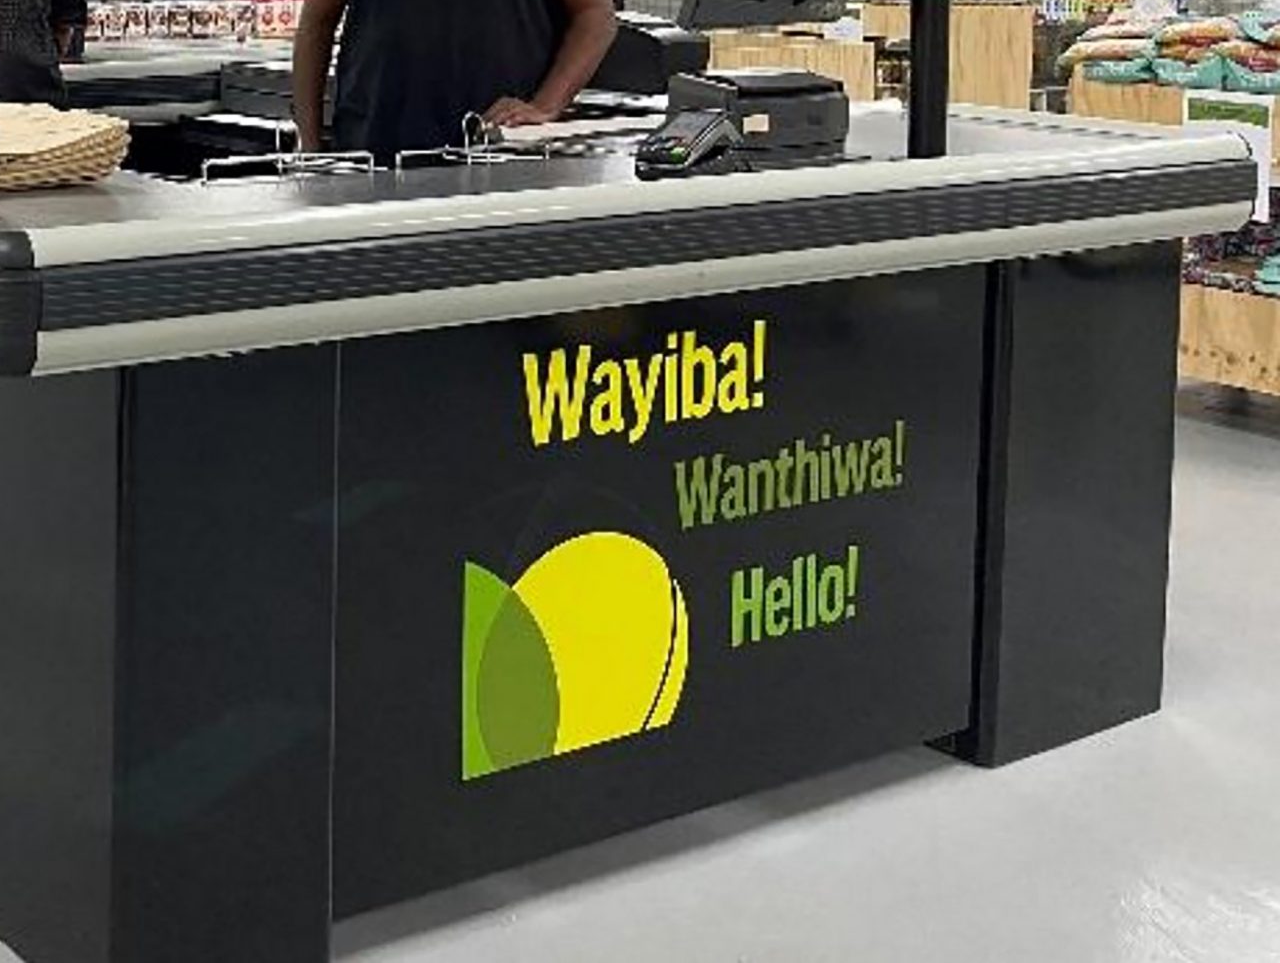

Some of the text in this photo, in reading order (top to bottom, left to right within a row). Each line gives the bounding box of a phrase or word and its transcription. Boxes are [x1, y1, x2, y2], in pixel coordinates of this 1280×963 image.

[523, 320, 766, 447] Wayiba!
[675, 421, 905, 530] Wanthiwa!
[732, 546, 858, 647] Hello!
